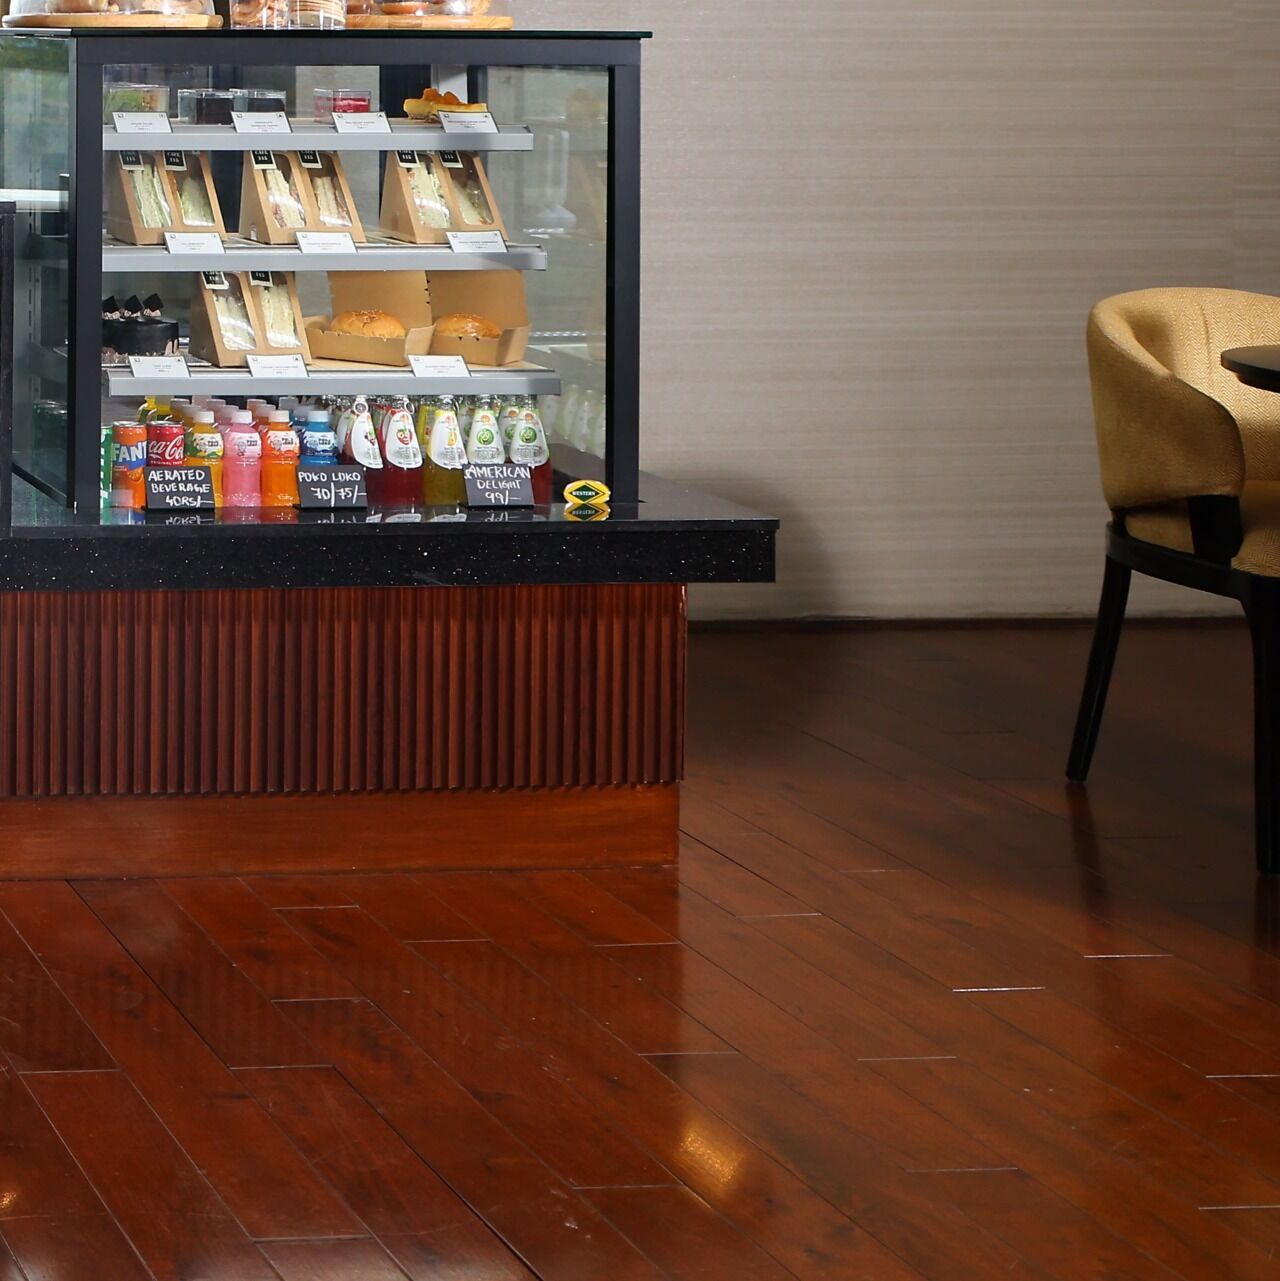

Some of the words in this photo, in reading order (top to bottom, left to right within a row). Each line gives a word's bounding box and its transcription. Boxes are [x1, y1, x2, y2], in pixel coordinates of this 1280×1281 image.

[148, 470, 206, 481] AERATED
[298, 471, 327, 482] POKO
[332, 472, 361, 482] LOKO
[465, 465, 531, 480] AMERICAN
[151, 482, 211, 493] BEVERAGE
[476, 480, 521, 490] DELIGHT
